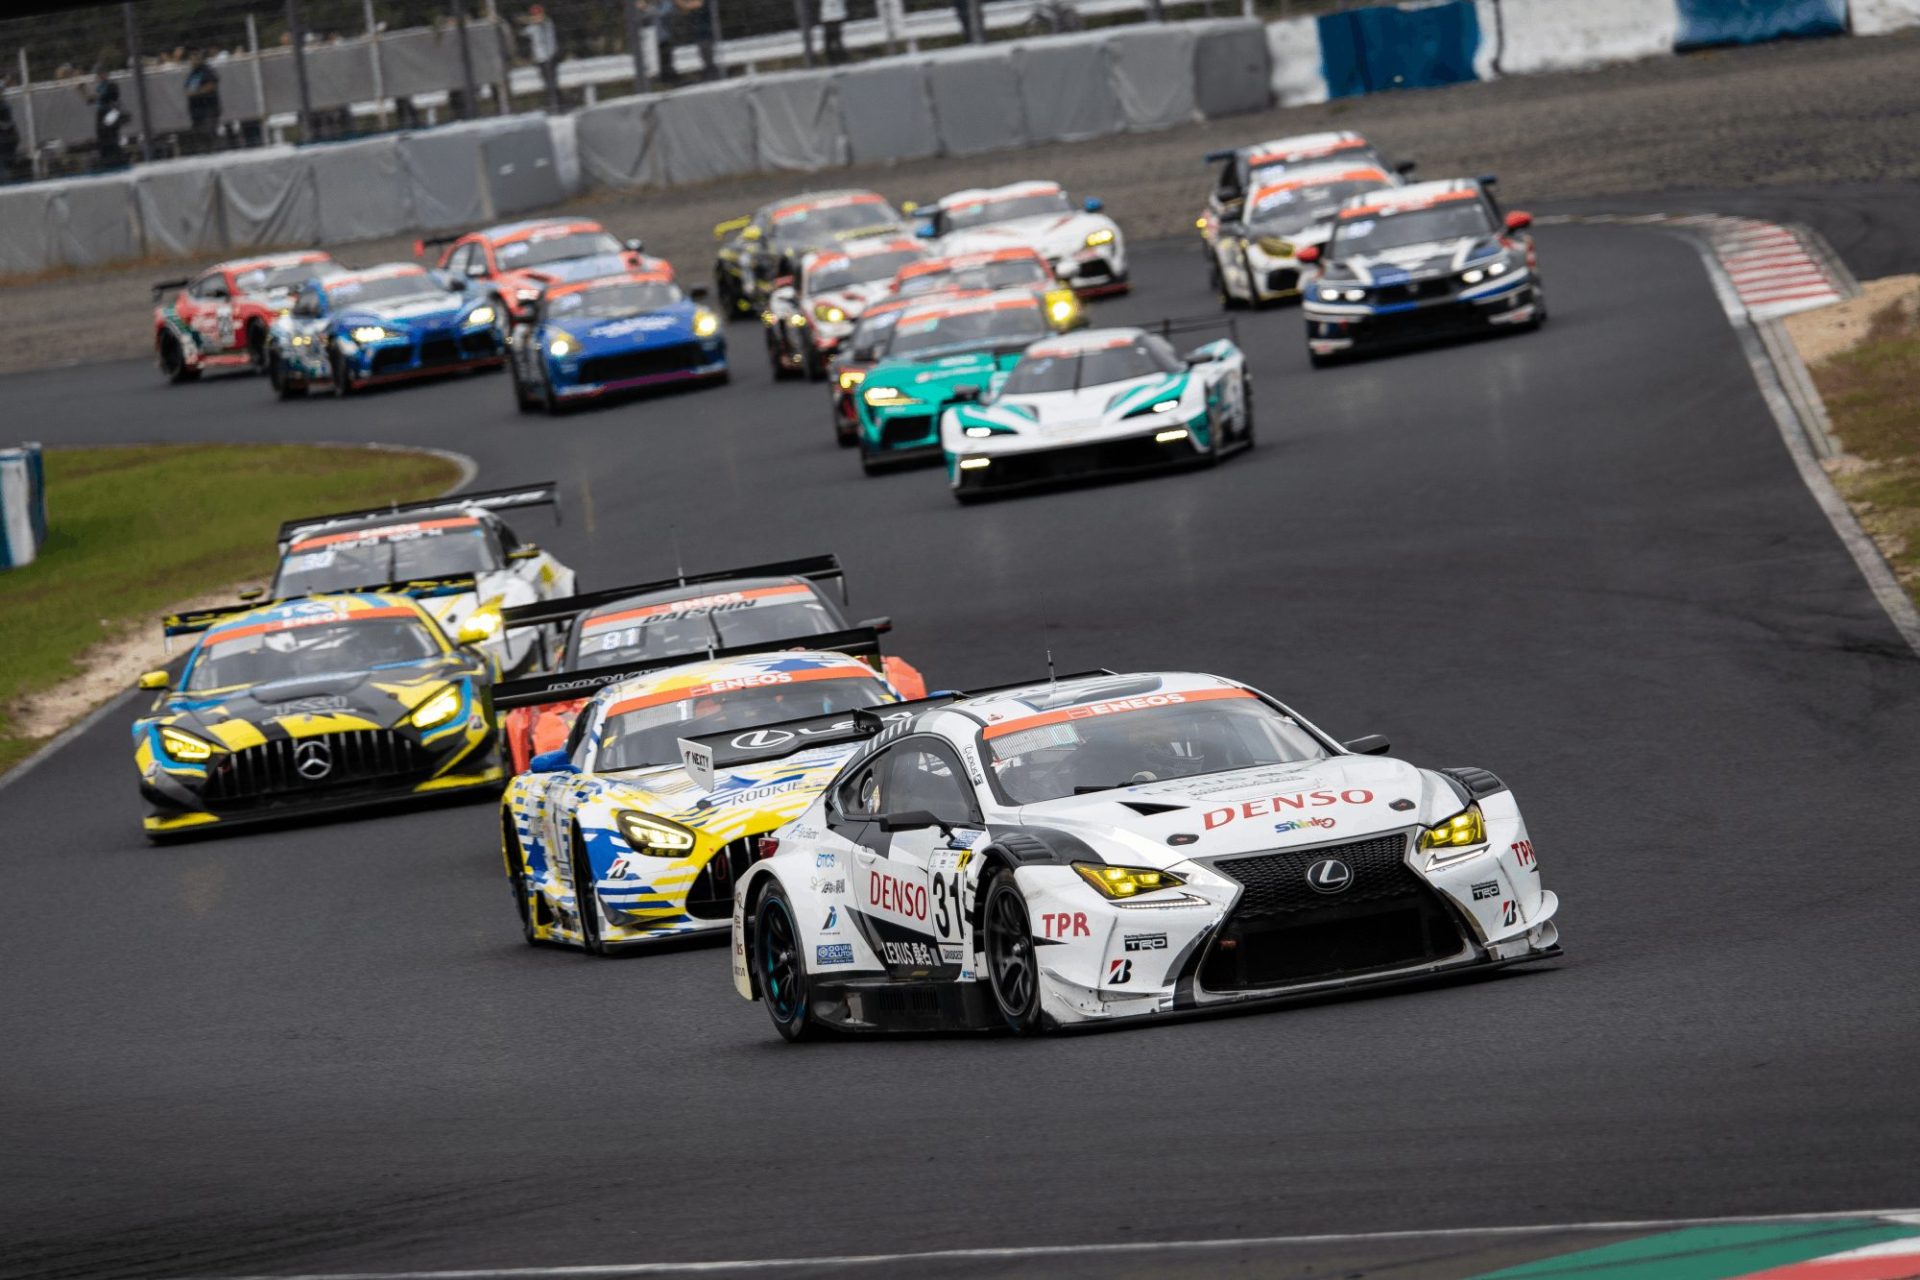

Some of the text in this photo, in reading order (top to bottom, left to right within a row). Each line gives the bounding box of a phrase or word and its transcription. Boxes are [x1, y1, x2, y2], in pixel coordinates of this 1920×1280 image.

[711, 672, 793, 693] ENEOS
[1091, 693, 1186, 714] ENEOS
[692, 751, 709, 768] NEXTY
[731, 783, 800, 806] ROOKIE
[1203, 789, 1374, 830] DENSO
[870, 871, 927, 921] DENSO
[1473, 884, 1500, 901] TRD
[1042, 911, 1091, 938] TPR
[881, 941, 914, 966] LEXUS
[1125, 937, 1168, 951] TRD
